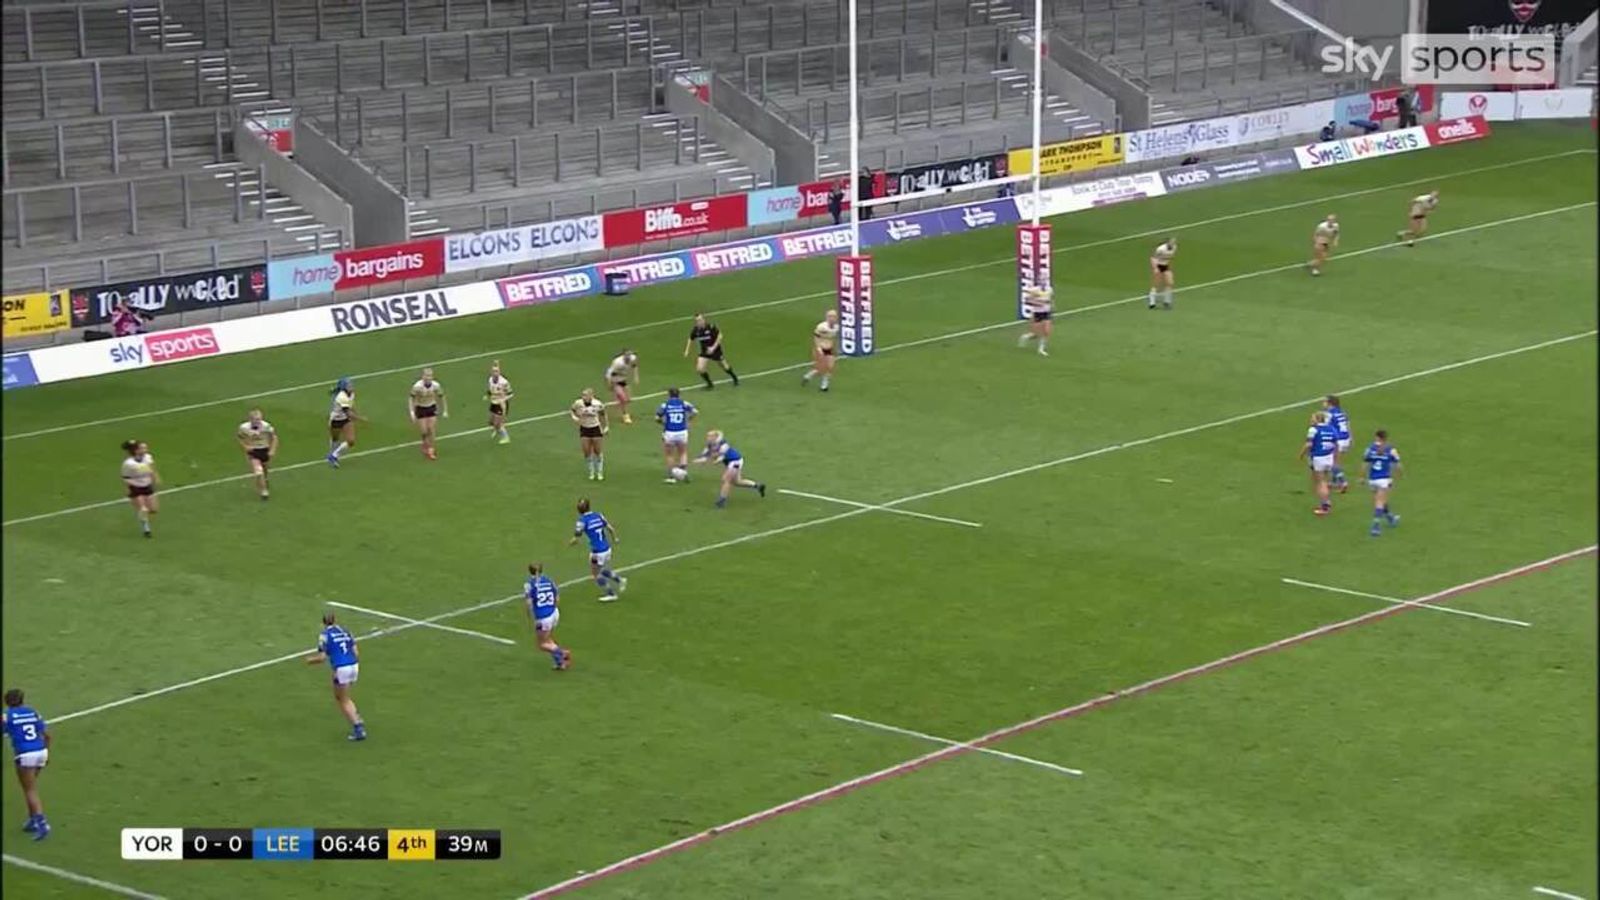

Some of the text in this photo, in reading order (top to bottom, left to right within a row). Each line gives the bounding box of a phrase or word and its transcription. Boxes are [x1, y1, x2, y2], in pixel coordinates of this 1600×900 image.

[1306, 138, 1352, 165] Small
[1353, 134, 1419, 156] Wonders
[449, 231, 521, 261] ELCONS
[531, 218, 599, 249] ELCONS
[782, 228, 854, 256] BETFRED
[292, 250, 424, 285] home bargains
[696, 243, 773, 271] BETFRED
[505, 272, 592, 302] BETFRED
[331, 291, 458, 333] RONSEAL
[840, 261, 855, 355] BETFRED
[860, 260, 873, 353] BETFRED
[109, 331, 215, 365] sky sports
[668, 412, 684, 424] 10
[537, 591, 555, 607] 23
[22, 724, 37, 741] 3
